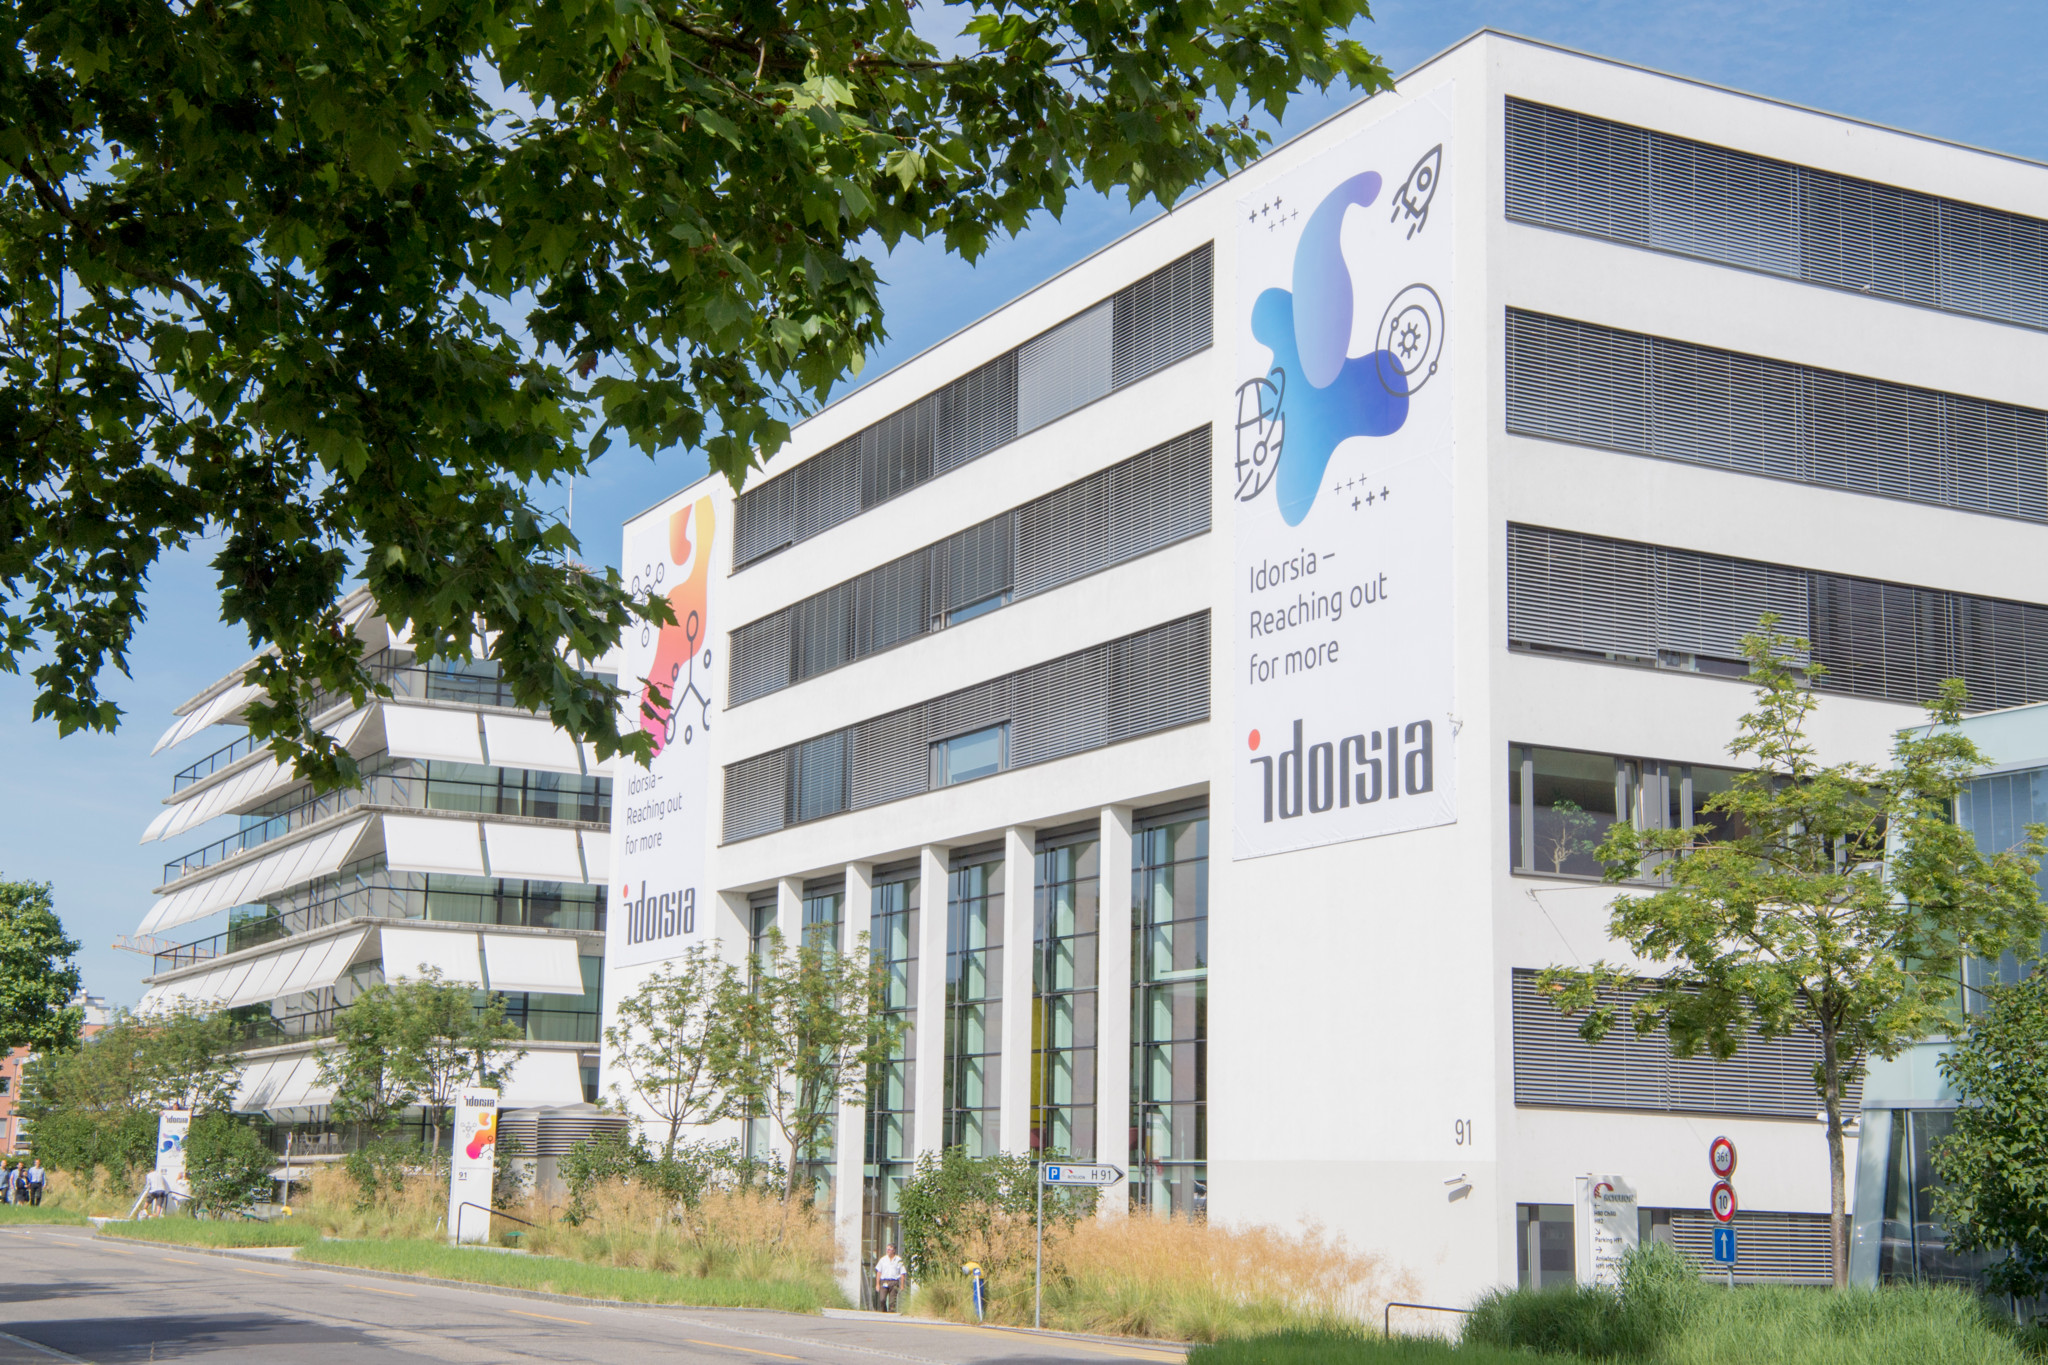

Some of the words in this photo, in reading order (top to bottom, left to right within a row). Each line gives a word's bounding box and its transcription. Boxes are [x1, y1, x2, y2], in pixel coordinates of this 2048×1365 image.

[1250, 547, 1317, 593] Idorsia
[1250, 591, 1342, 639] Reaching
[1350, 572, 1388, 609] out
[1250, 653, 1279, 685] for
[1285, 640, 1339, 676] more
[1248, 718, 1434, 824] idorsia
[628, 773, 656, 797] Idorsia
[626, 799, 665, 826] Reaching
[667, 792, 683, 814] out
[625, 835, 638, 855] for
[639, 831, 662, 852] more
[623, 880, 696, 945] idorsia
[463, 1095, 495, 1108] idorsia
[1455, 1118, 1472, 1146] 91
[458, 1171, 468, 1179] 91
[1051, 1168, 1058, 1179] P
[1091, 1169, 1098, 1180] H
[1100, 1169, 1111, 1180] 91
[1718, 1195, 1728, 1209] 10
[1595, 1236, 1613, 1245] Parking
